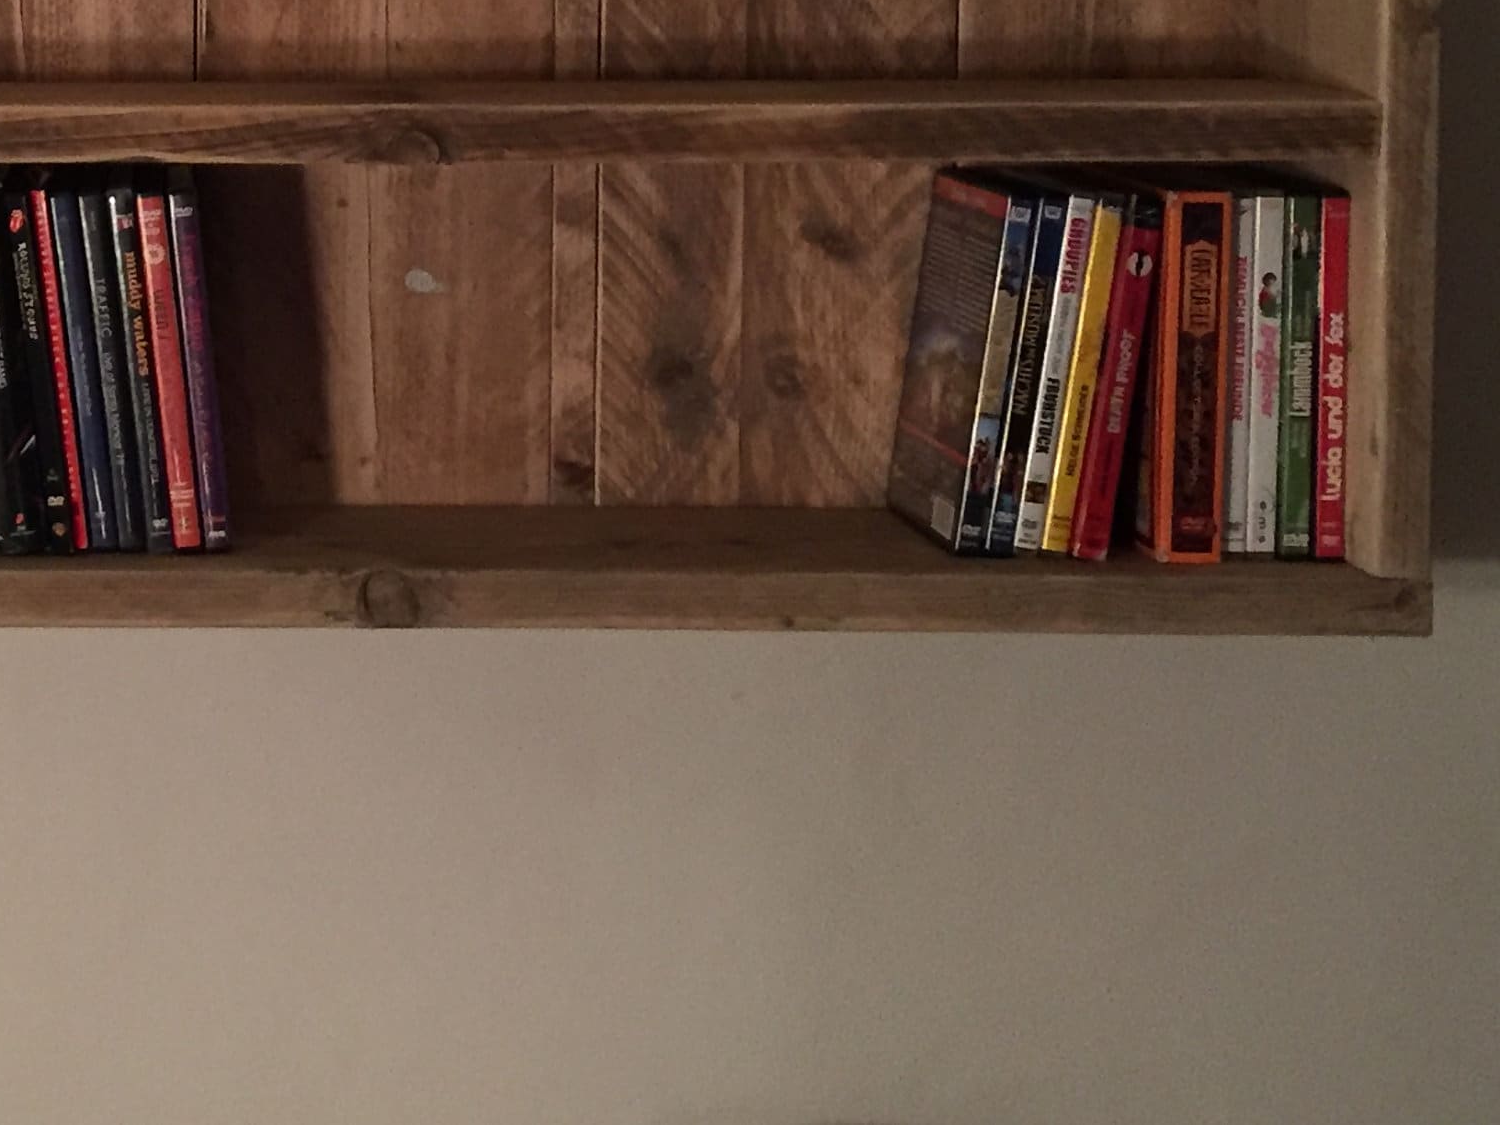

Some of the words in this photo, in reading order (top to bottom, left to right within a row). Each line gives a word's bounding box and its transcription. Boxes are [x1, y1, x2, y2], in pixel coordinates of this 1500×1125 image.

[16, 242, 33, 290] ROLLING
[123, 251, 144, 311] muddy
[1060, 217, 1091, 295] GROUPIES
[22, 291, 39, 340] STONES
[94, 278, 113, 339] TRAFFIC
[1235, 255, 1248, 318] ZIEMLICH
[133, 315, 152, 378] waters
[1114, 328, 1137, 384] PROOF
[1234, 322, 1247, 358] BESTE
[1010, 359, 1035, 416] NACHTS
[1231, 362, 1246, 422] FREUNDE
[1286, 341, 1313, 417] Lammbock
[1321, 352, 1345, 389] der
[1322, 395, 1344, 440] und
